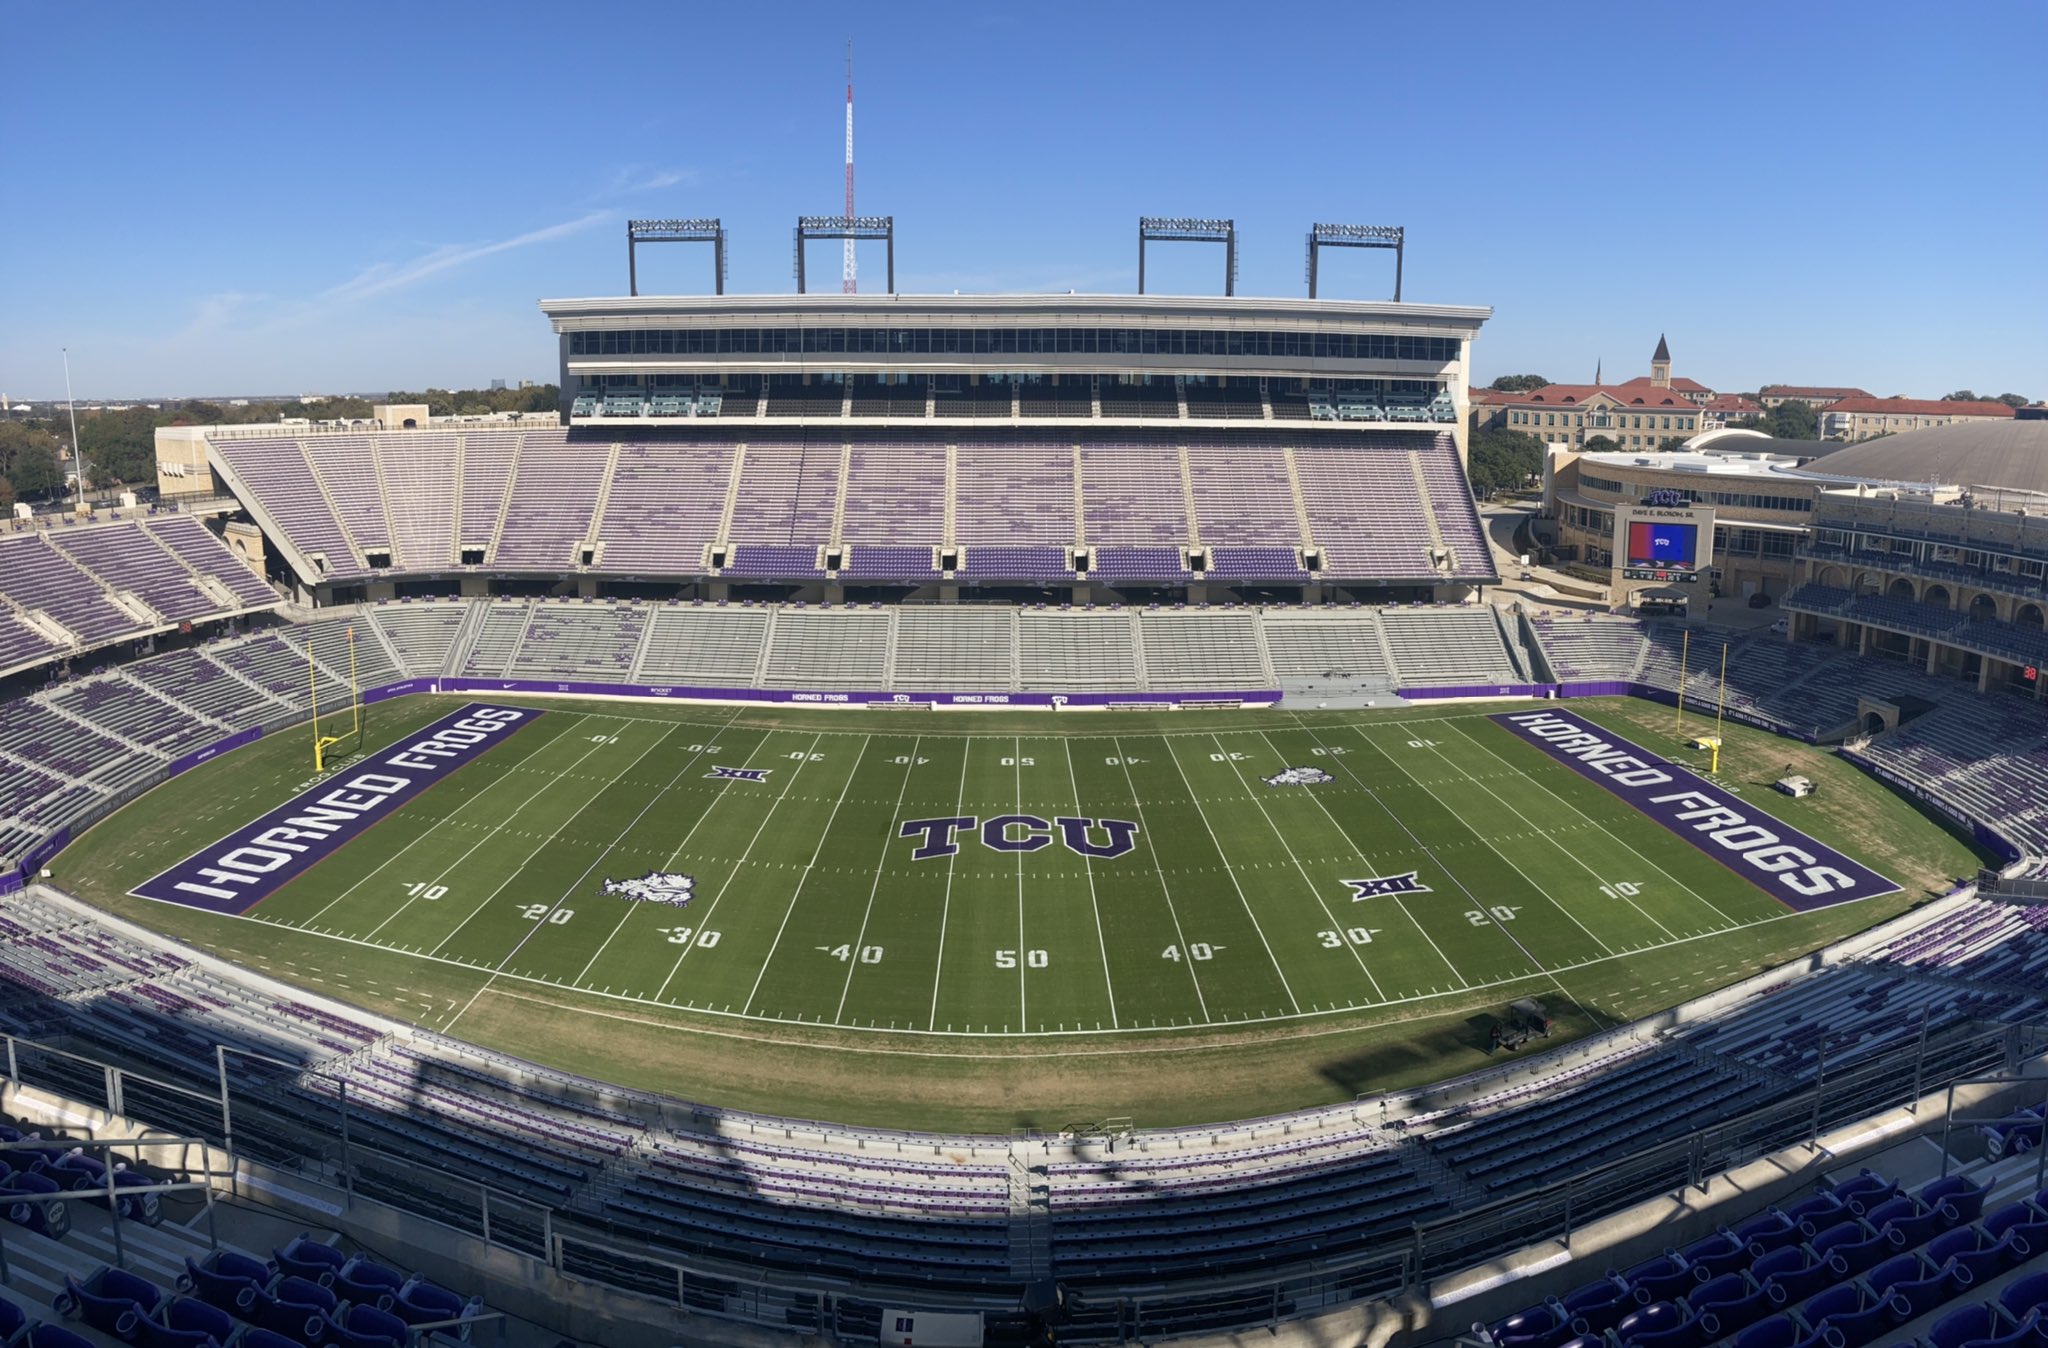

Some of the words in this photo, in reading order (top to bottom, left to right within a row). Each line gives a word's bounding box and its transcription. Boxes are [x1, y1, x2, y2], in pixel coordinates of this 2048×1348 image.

[1651, 490, 1680, 506] TCU
[1655, 538, 1670, 546] TCU
[2024, 665, 2037, 681] 38
[824, 694, 848, 702] FROGS
[893, 694, 910, 702] TCU
[331, 754, 366, 772] CLUB
[174, 774, 411, 899] HORNED
[386, 707, 523, 770] FROGS
[1509, 714, 1673, 787] HORNED
[1649, 791, 1857, 896] FROGS
[899, 815, 1139, 860] TCU
[408, 883, 449, 899] 10
[1599, 881, 1640, 899] 10
[522, 904, 575, 926] 20
[1464, 905, 1516, 927] 20
[667, 927, 722, 949] 30
[1317, 927, 1373, 949] 30
[831, 943, 884, 964] 40
[995, 950, 1049, 968] 50
[1161, 942, 1213, 962] 40
